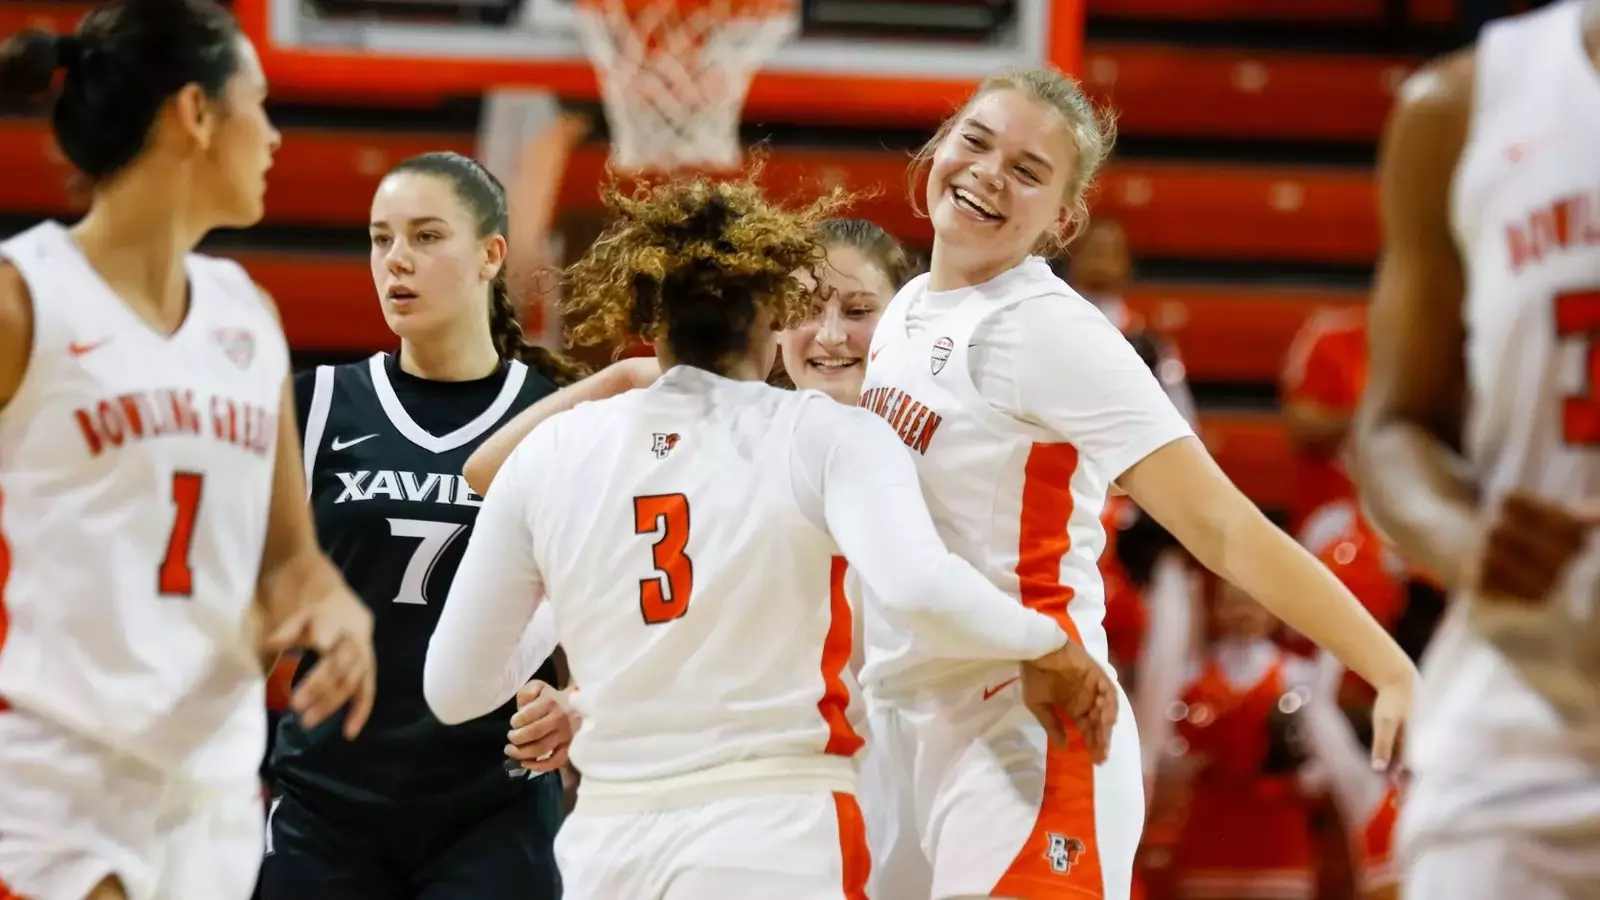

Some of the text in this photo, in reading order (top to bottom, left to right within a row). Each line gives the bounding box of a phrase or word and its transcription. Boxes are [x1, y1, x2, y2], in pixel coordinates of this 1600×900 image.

[157, 470, 204, 597] 1
[385, 517, 468, 605] 7
[633, 493, 693, 625] 3
